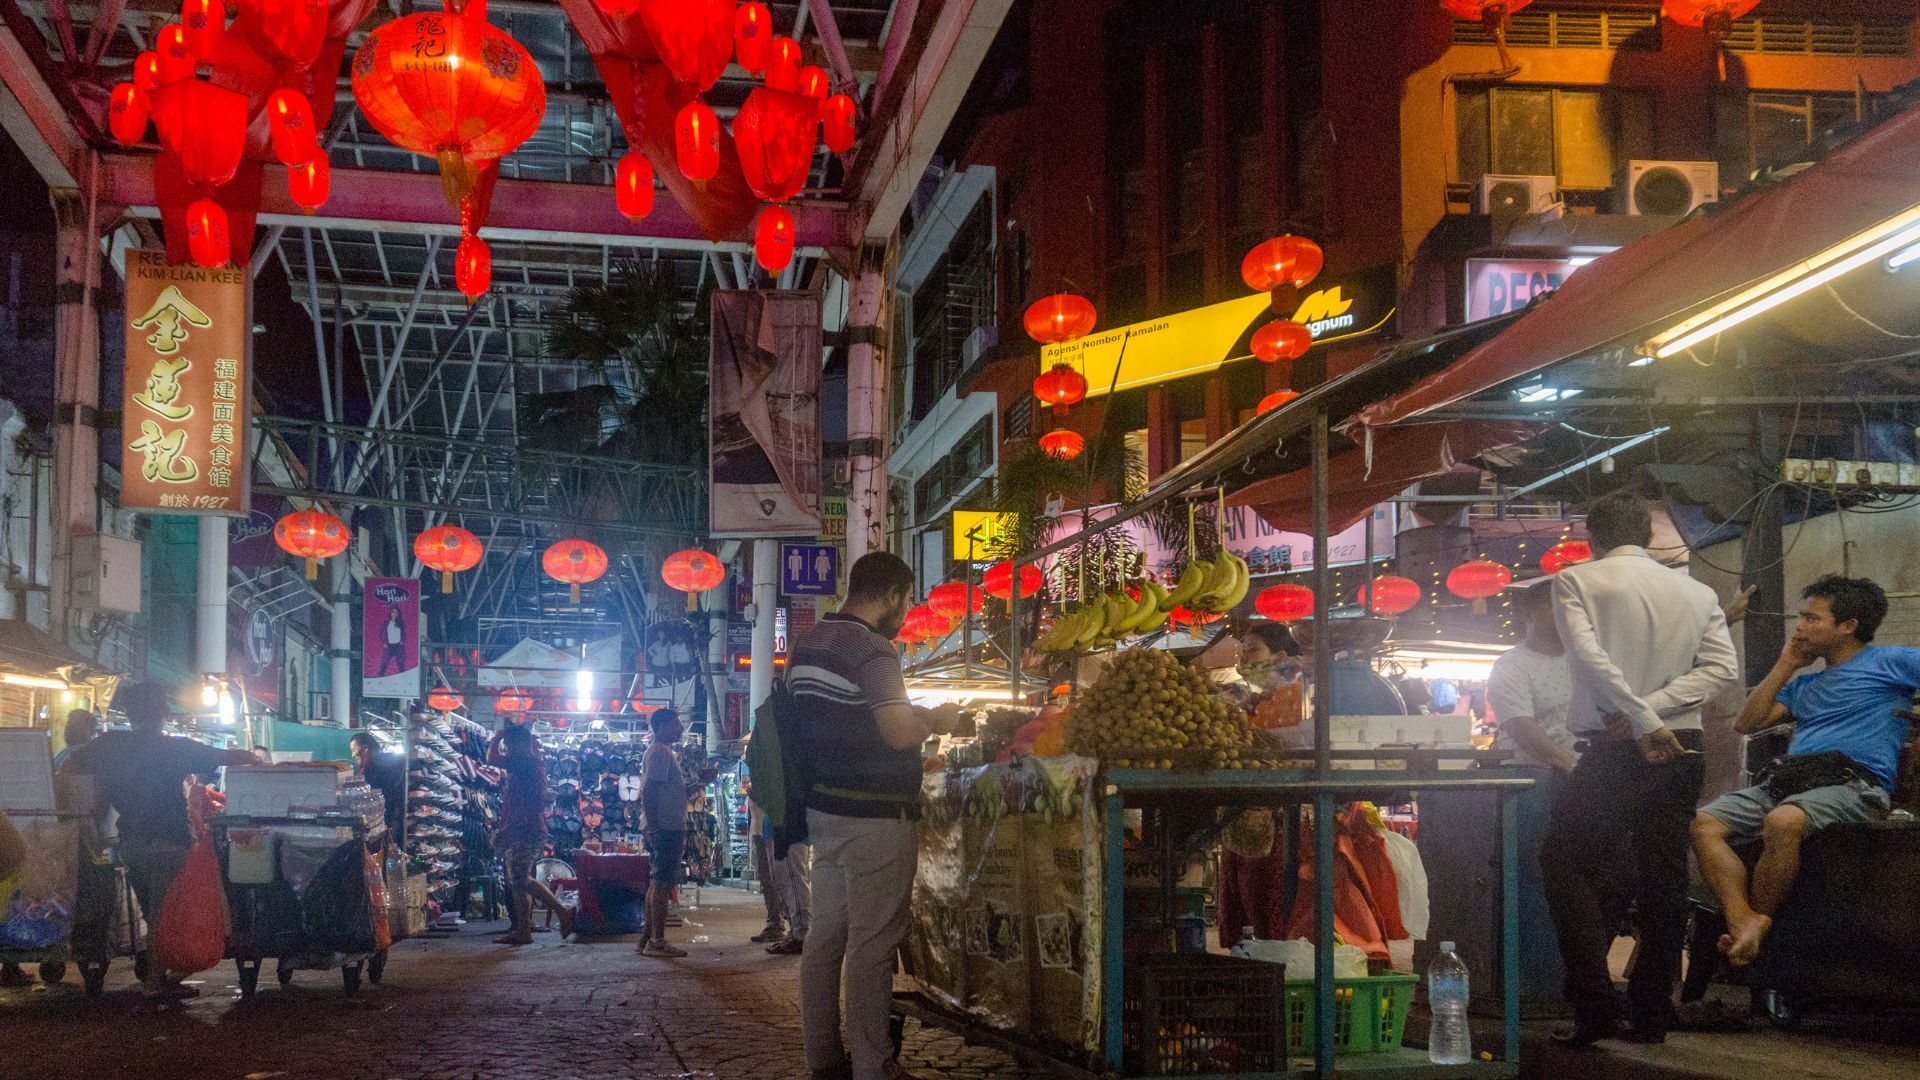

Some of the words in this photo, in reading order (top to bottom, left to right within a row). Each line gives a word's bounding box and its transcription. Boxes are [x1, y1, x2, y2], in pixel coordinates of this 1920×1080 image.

[138, 267, 165, 280] KIM
[170, 270, 206, 282] LIAN
[211, 272, 243, 284] KEE
[1047, 343, 1080, 357] Agensi
[1083, 334, 1122, 349] Nombor
[210, 359, 237, 486] 福建面美食馆
[192, 495, 229, 509] 1927
[238, 523, 268, 536] Hari
[1328, 545, 1358, 559] 1927
[376, 587, 397, 596] Hari
[387, 593, 407, 603] Hari
